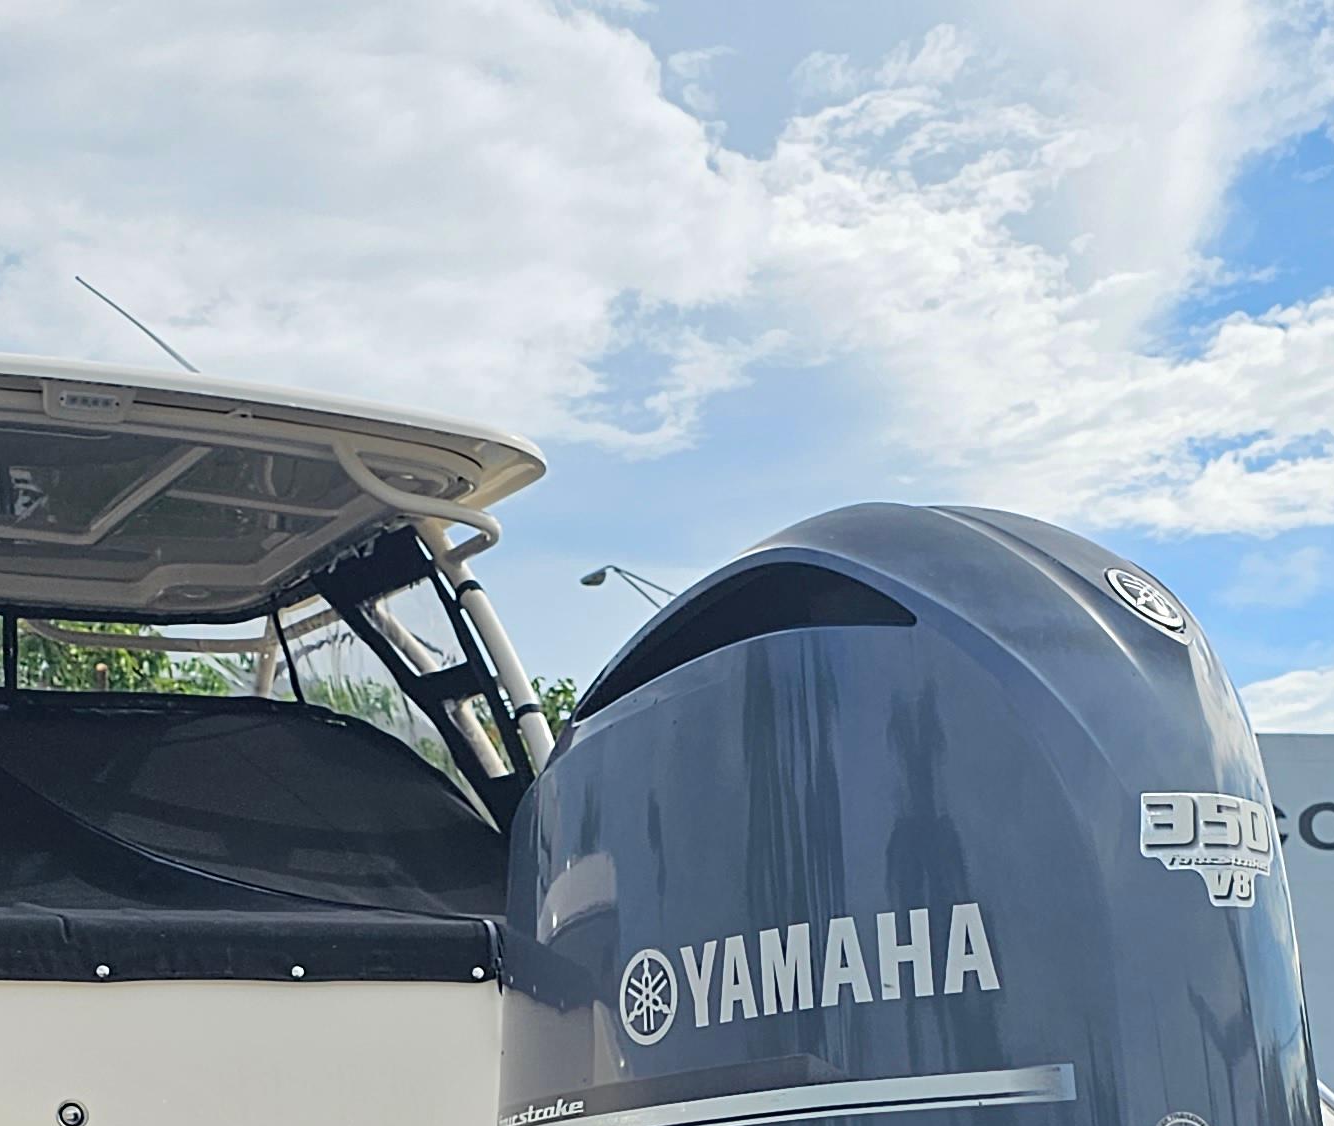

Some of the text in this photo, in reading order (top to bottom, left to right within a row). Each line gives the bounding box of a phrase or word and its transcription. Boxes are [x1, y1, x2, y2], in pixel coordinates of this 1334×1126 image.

[1143, 795, 1269, 853] 350
[1206, 870, 1252, 900] V8
[680, 902, 1000, 1028] YAMAHA
